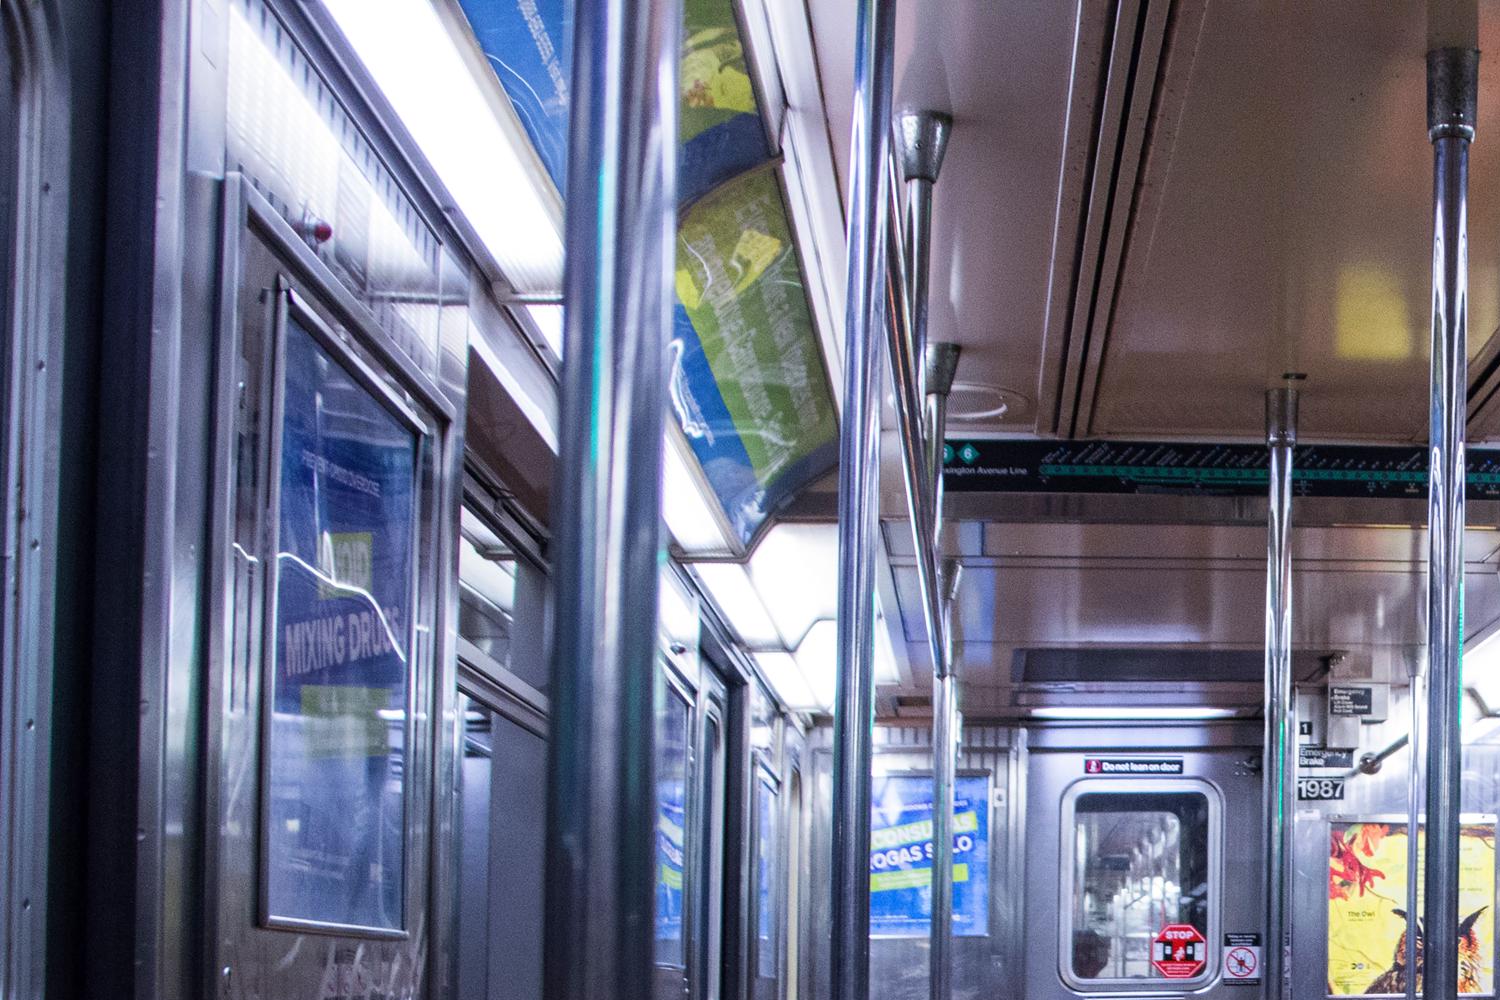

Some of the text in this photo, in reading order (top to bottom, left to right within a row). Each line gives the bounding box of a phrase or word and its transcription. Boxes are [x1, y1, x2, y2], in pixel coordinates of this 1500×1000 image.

[964, 448, 972, 459] 6
[977, 466, 1008, 475] Avenue
[1009, 466, 1028, 475] Line
[285, 614, 343, 677] MIXING
[1102, 761, 1180, 771] Do not lean on door
[1300, 756, 1325, 765] Brake
[1298, 780, 1343, 798] 1987
[874, 814, 972, 847] CONSUAS
[871, 835, 972, 870] OGAS SO
[1166, 930, 1194, 939] STOP
